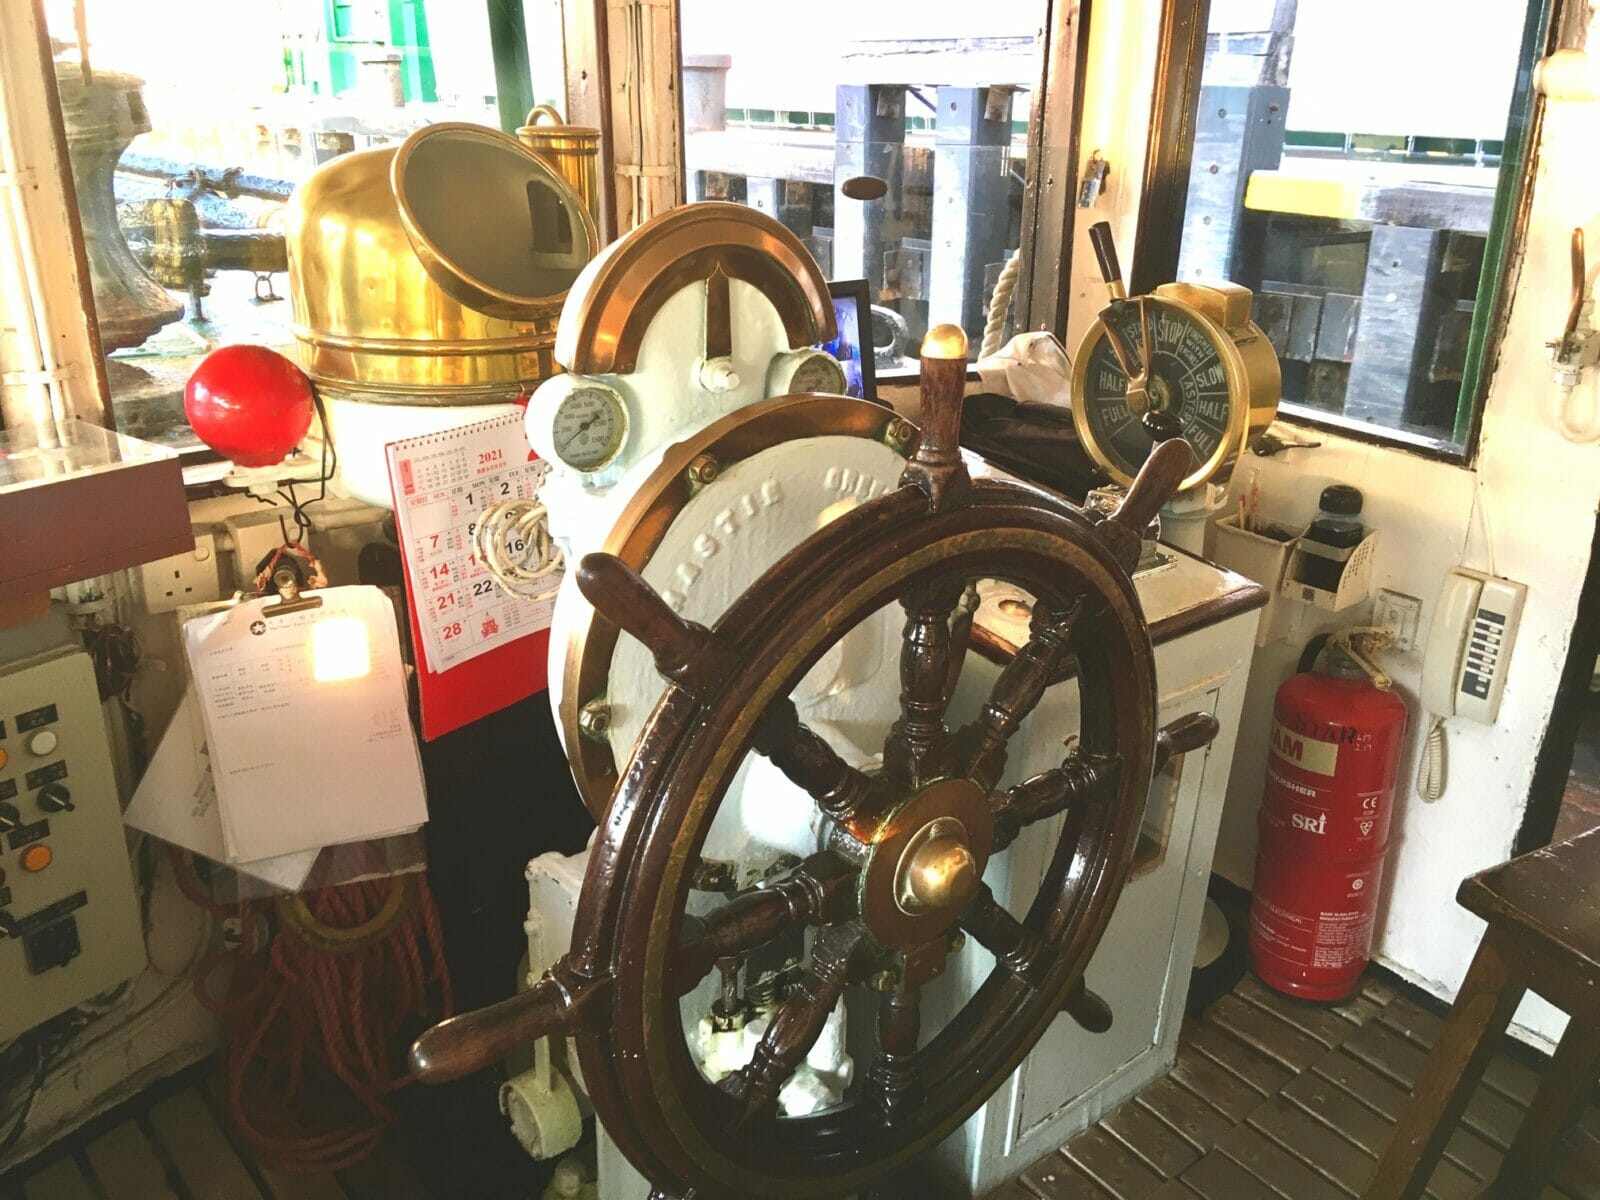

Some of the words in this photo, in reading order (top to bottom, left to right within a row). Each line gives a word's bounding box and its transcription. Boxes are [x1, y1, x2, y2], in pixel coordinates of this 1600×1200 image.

[1157, 318, 1184, 345] STOP
[1186, 338, 1205, 359] WITH
[1099, 369, 1126, 393] HALF
[1195, 363, 1226, 389] SLOW
[1101, 403, 1129, 427] FULL
[1199, 399, 1230, 423] HALF
[1188, 423, 1217, 457] FULL
[478, 447, 503, 466] 2021
[507, 469, 521, 479] TUE
[471, 480, 487, 490] MON
[499, 481, 512, 497] 2
[433, 491, 447, 500] SUN
[465, 492, 475, 506] 1
[429, 534, 440, 549] 7
[505, 539, 525, 555] 16
[429, 562, 450, 580] 14
[472, 579, 493, 597] 22
[436, 591, 456, 611] 21
[442, 622, 462, 641] 28
[1271, 727, 1305, 763] AM
[1362, 797, 1378, 810] CE
